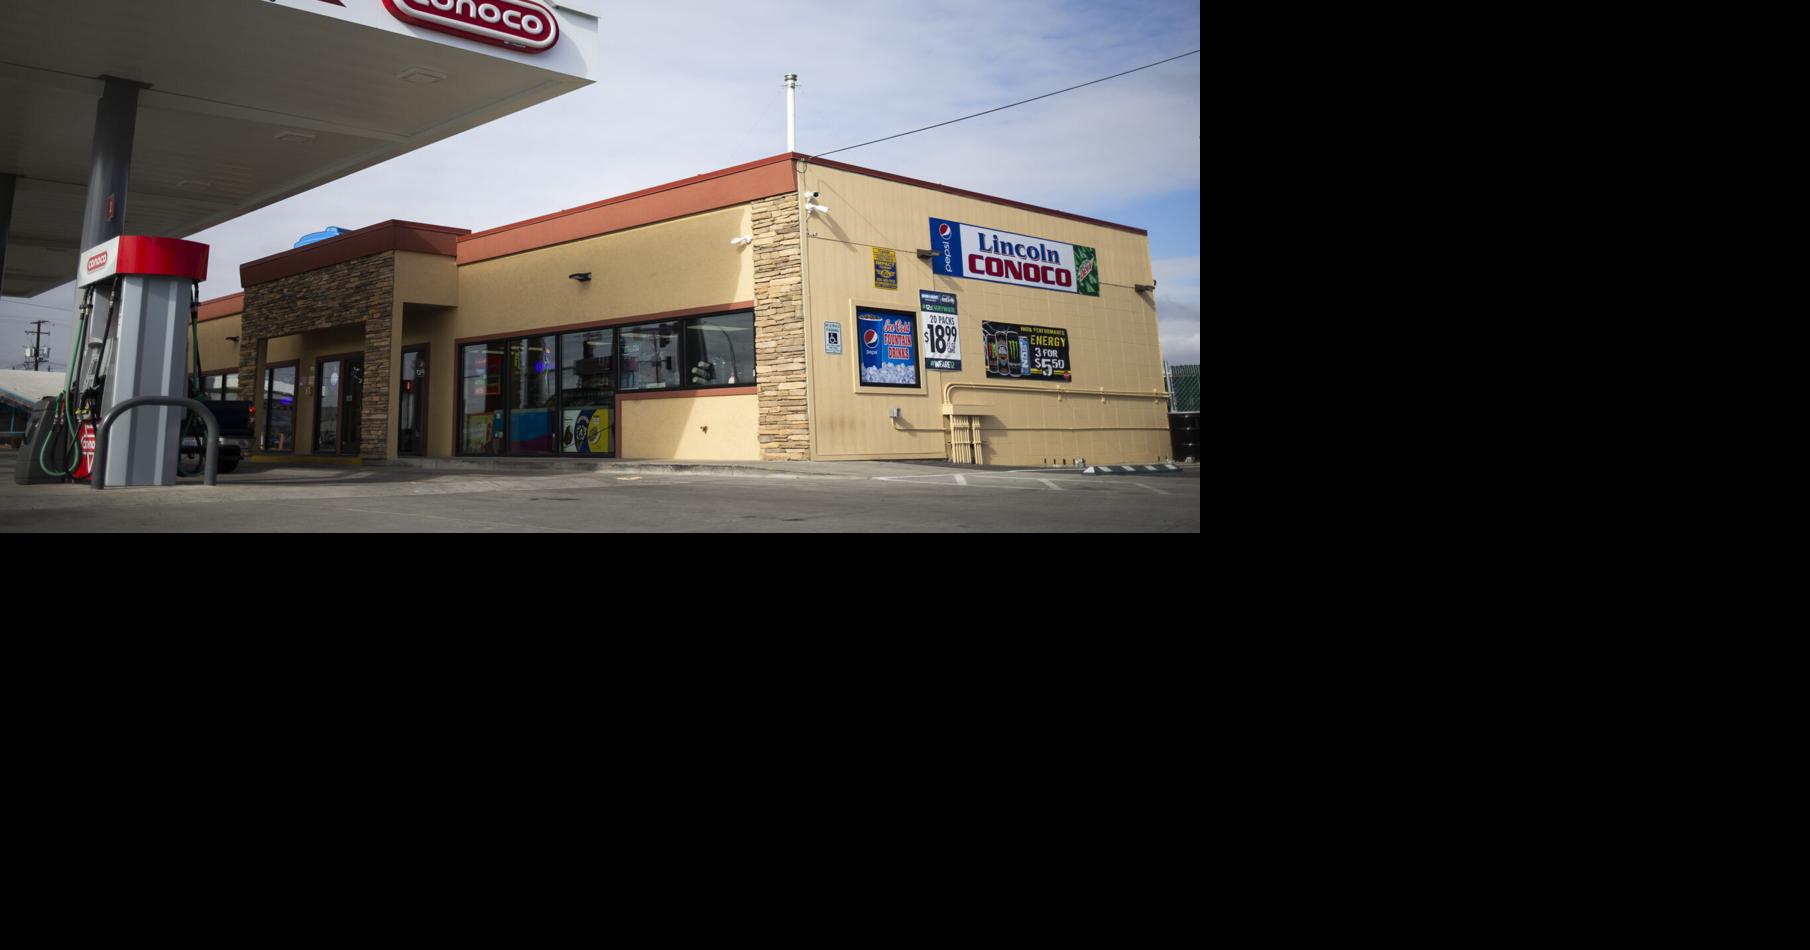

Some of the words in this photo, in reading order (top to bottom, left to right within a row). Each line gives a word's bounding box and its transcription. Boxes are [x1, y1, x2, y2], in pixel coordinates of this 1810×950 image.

[977, 232, 1061, 265] Lincoln
[943, 241, 953, 273] pepsi
[968, 253, 1072, 288] CONOCO
[929, 314, 937, 324] 20
[938, 315, 955, 325] PACKS
[883, 332, 912, 347] FOUNTAIN
[1030, 335, 1066, 347] ENERGY
[888, 346, 909, 360] DRINKS
[1034, 347, 1042, 357] 3
[1043, 349, 1058, 357] FOR
